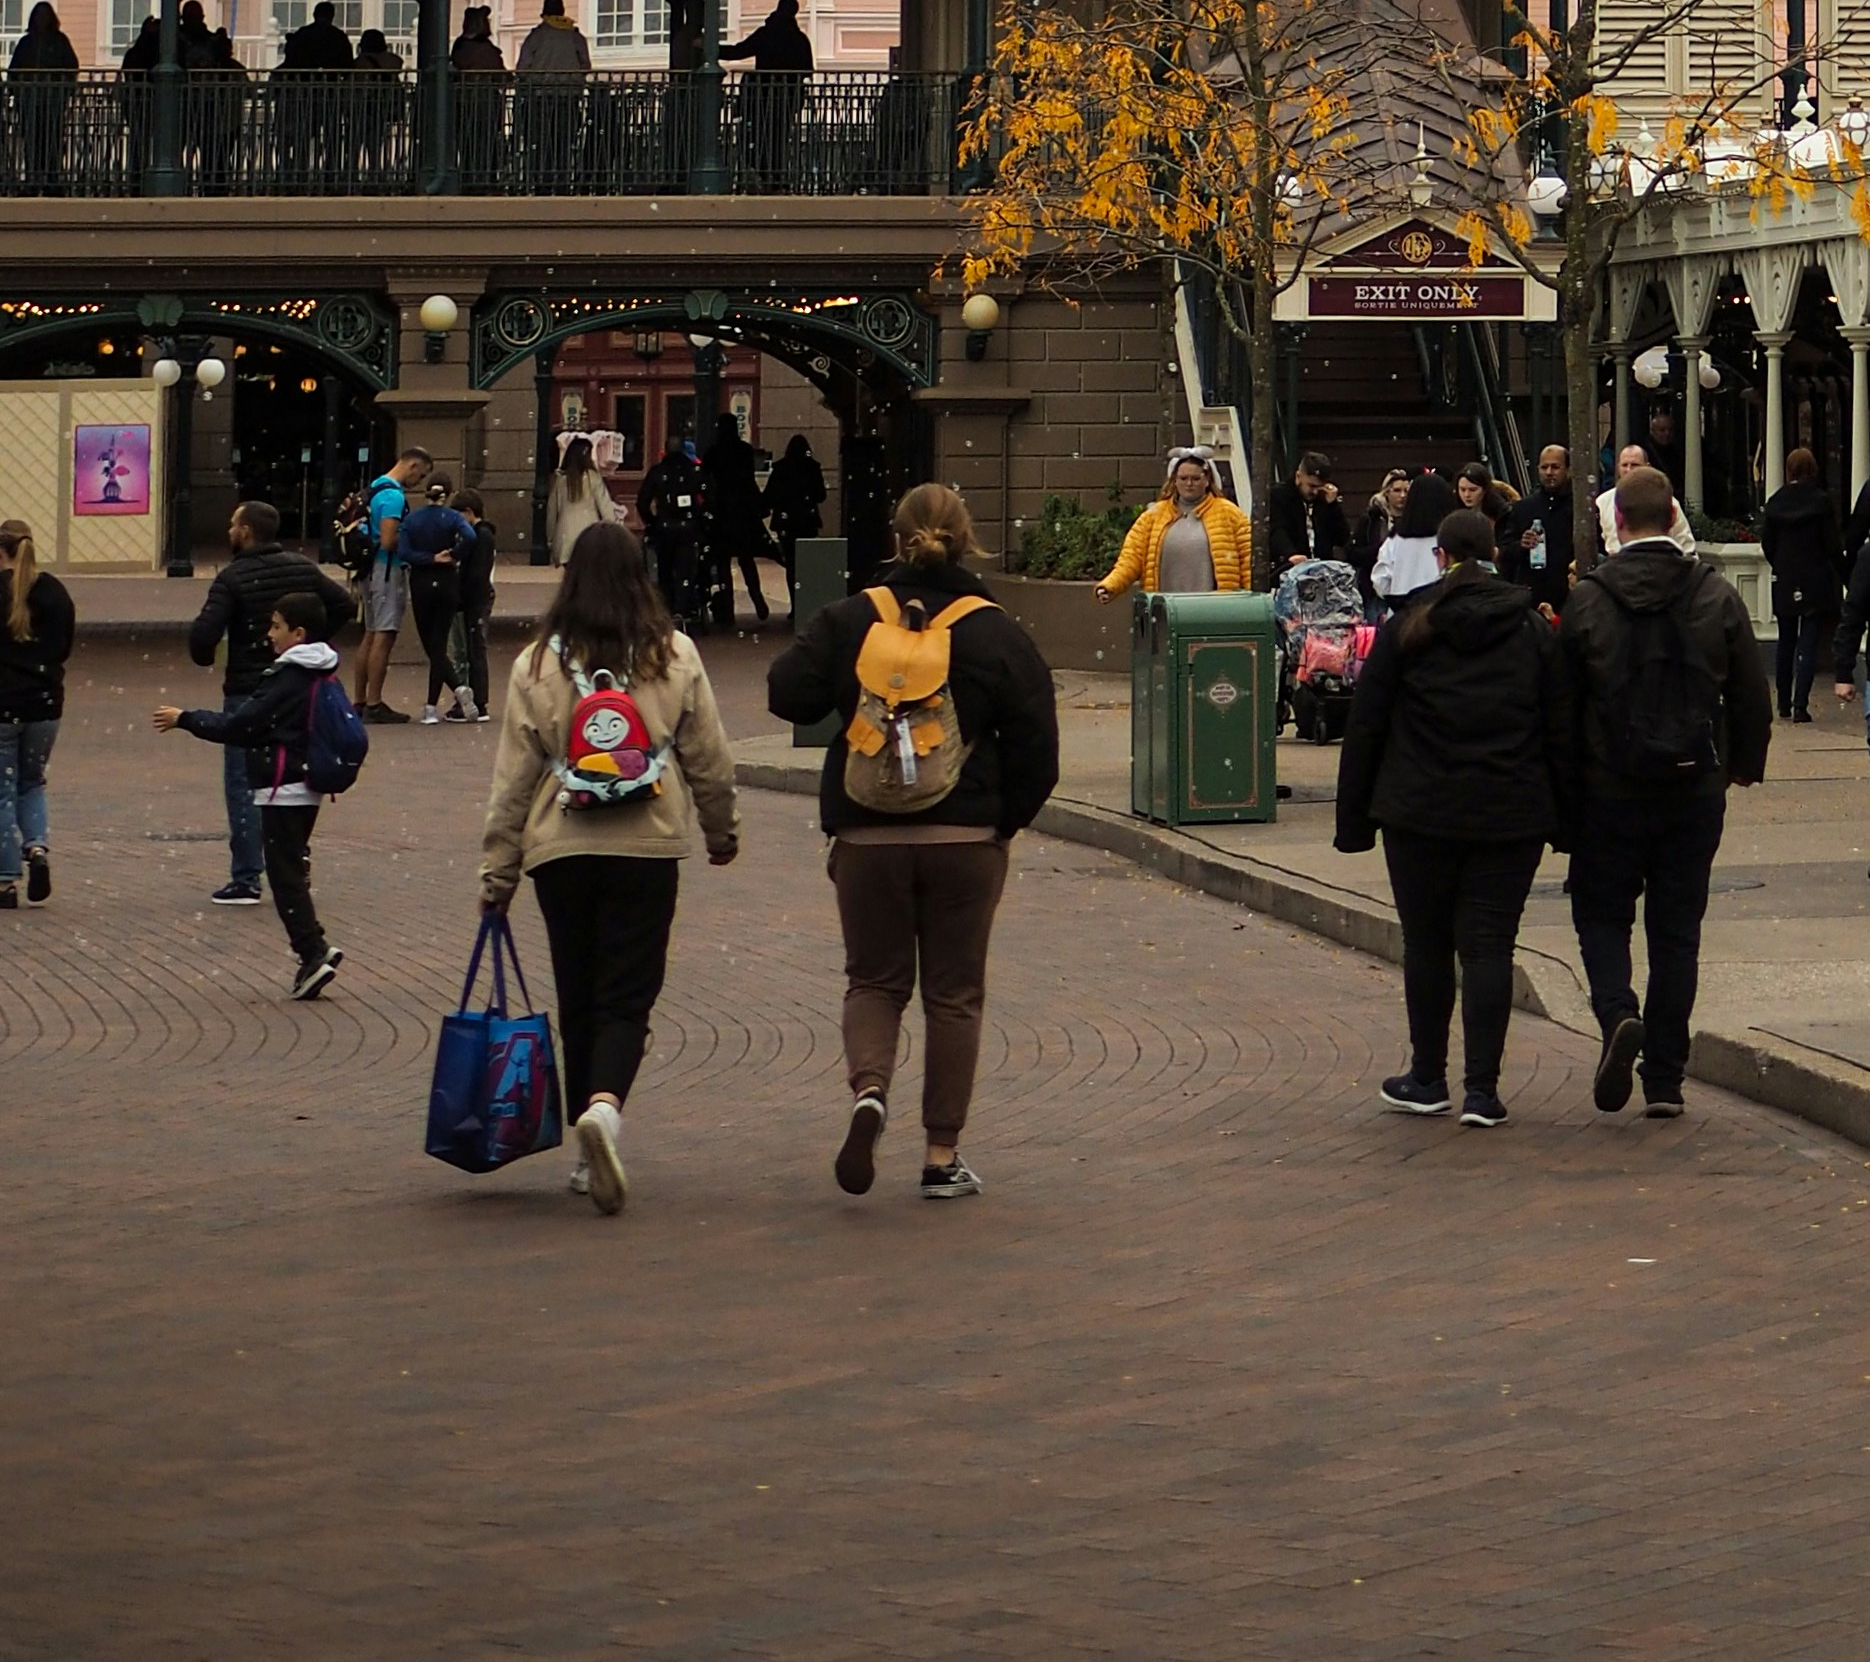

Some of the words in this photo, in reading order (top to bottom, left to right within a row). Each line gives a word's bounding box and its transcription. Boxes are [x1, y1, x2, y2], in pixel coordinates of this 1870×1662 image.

[1355, 285, 1412, 300] EXIT
[1417, 285, 1480, 300] ONLY
[1354, 301, 1397, 309] SORTIE
